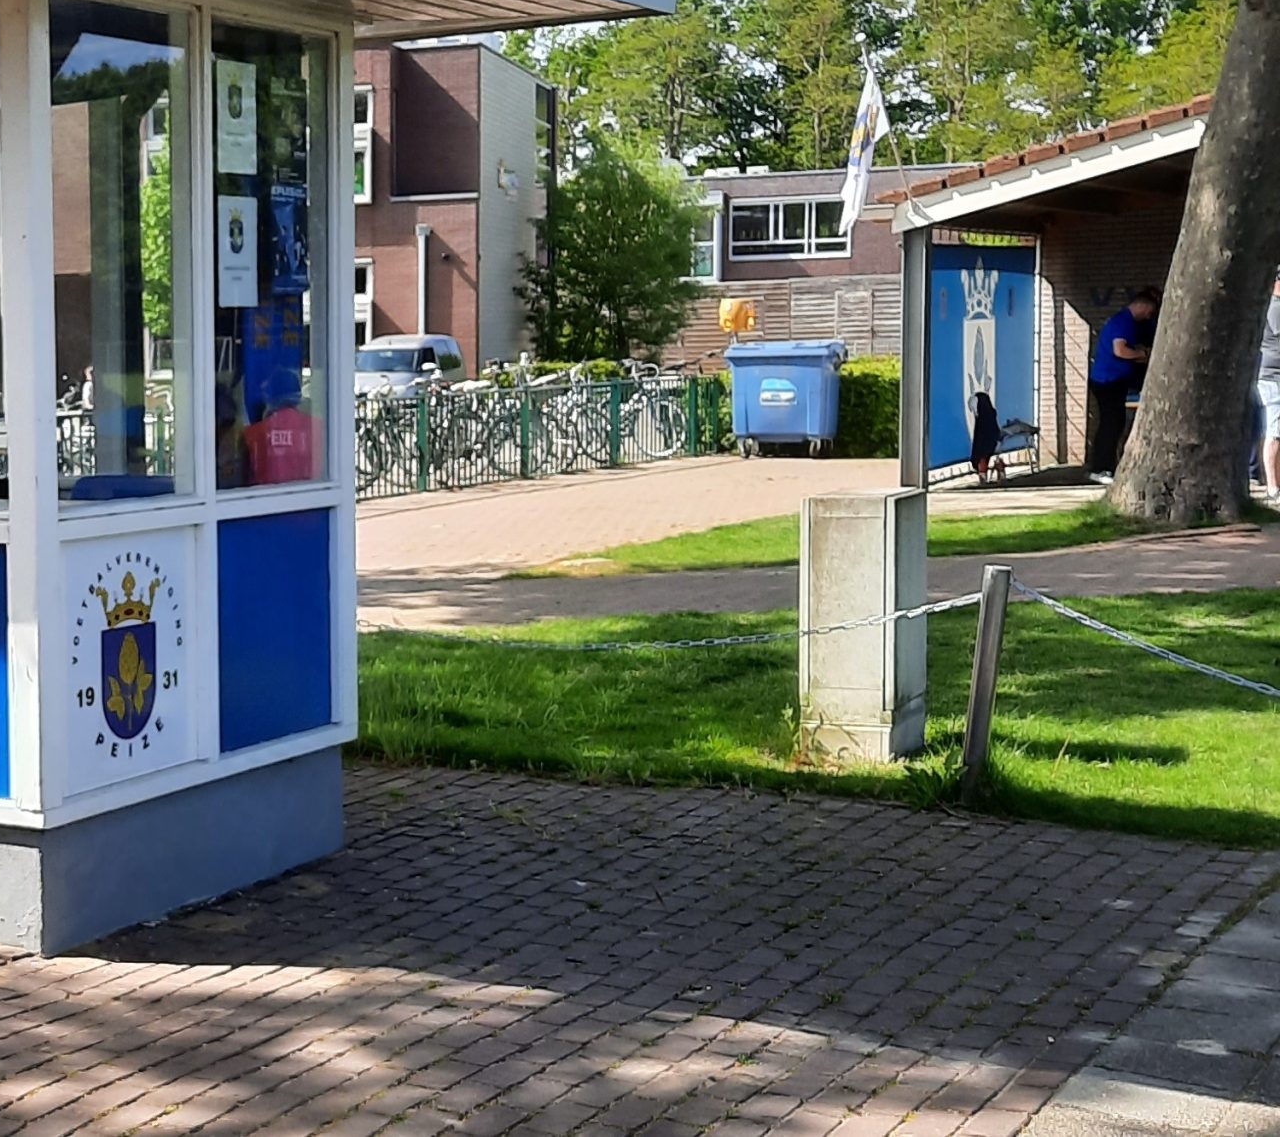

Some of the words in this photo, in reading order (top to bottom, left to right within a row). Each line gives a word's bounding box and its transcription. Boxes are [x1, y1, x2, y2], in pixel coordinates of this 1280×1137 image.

[76, 686, 96, 708] 19
[162, 669, 179, 690] 31
[95, 717, 165, 758] PEIZE
